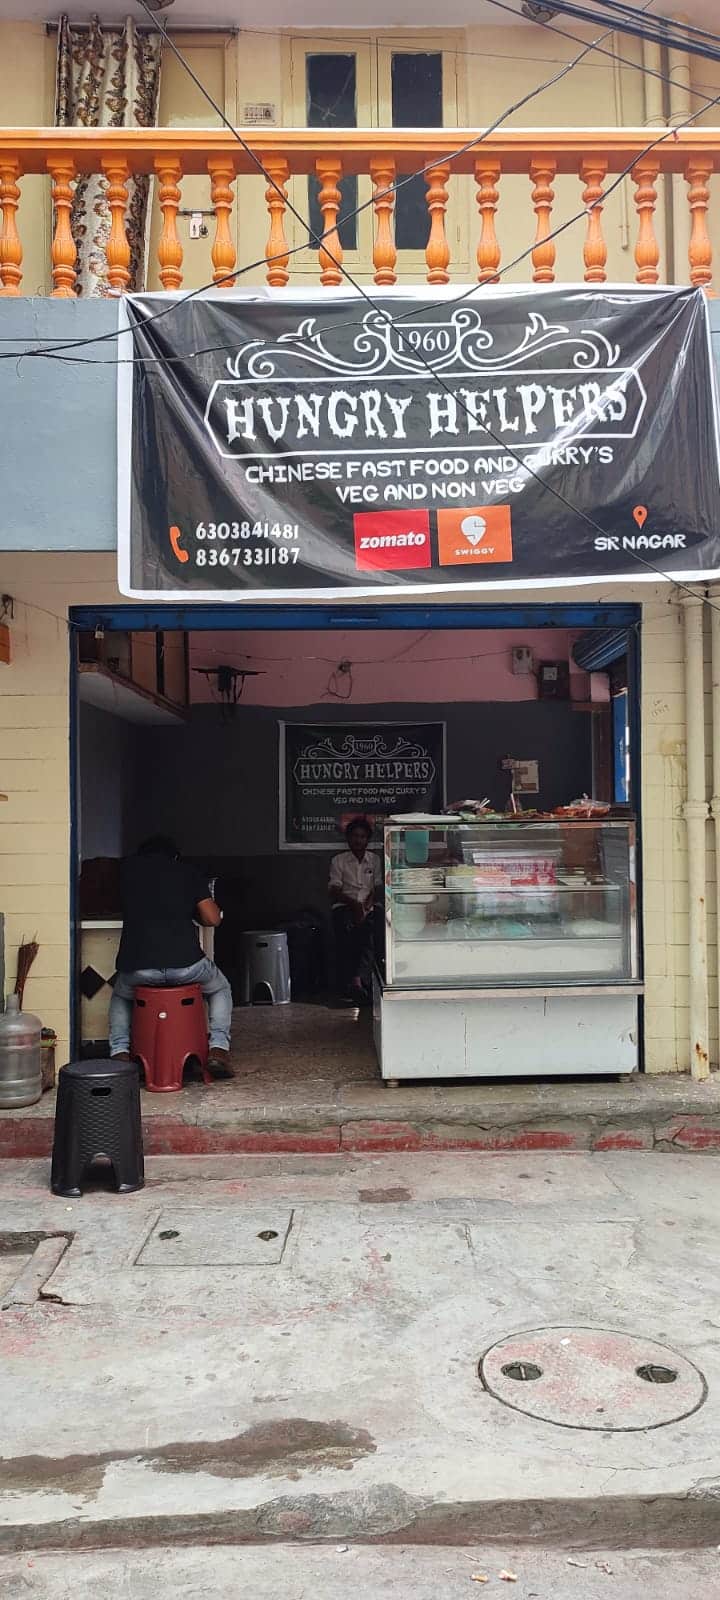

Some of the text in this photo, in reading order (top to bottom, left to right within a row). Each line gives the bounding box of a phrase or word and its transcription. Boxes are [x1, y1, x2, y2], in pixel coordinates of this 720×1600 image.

[396, 329, 450, 353] 1960
[224, 381, 627, 443] HUNGRY HELPERS
[245, 462, 342, 484] CHINESE
[346, 460, 405, 478] FAST
[409, 457, 469, 476] FOOD
[474, 456, 518, 474] AND
[335, 477, 525, 504] VEG AND NON VEG
[196, 521, 299, 540] 6303841481
[360, 531, 426, 549] zomato
[455, 547, 495, 556] SWIGGY
[594, 534, 687, 551] SR NAGAR
[196, 547, 300, 566] 8367331187
[355, 741, 374, 751] 1960
[300, 761, 430, 780] HUNGRY HELPERS
[302, 788, 336, 796] CHINESE
[336, 787, 355, 796] FAST
[358, 786, 379, 795] FOOD
[379, 787, 395, 795] AND
